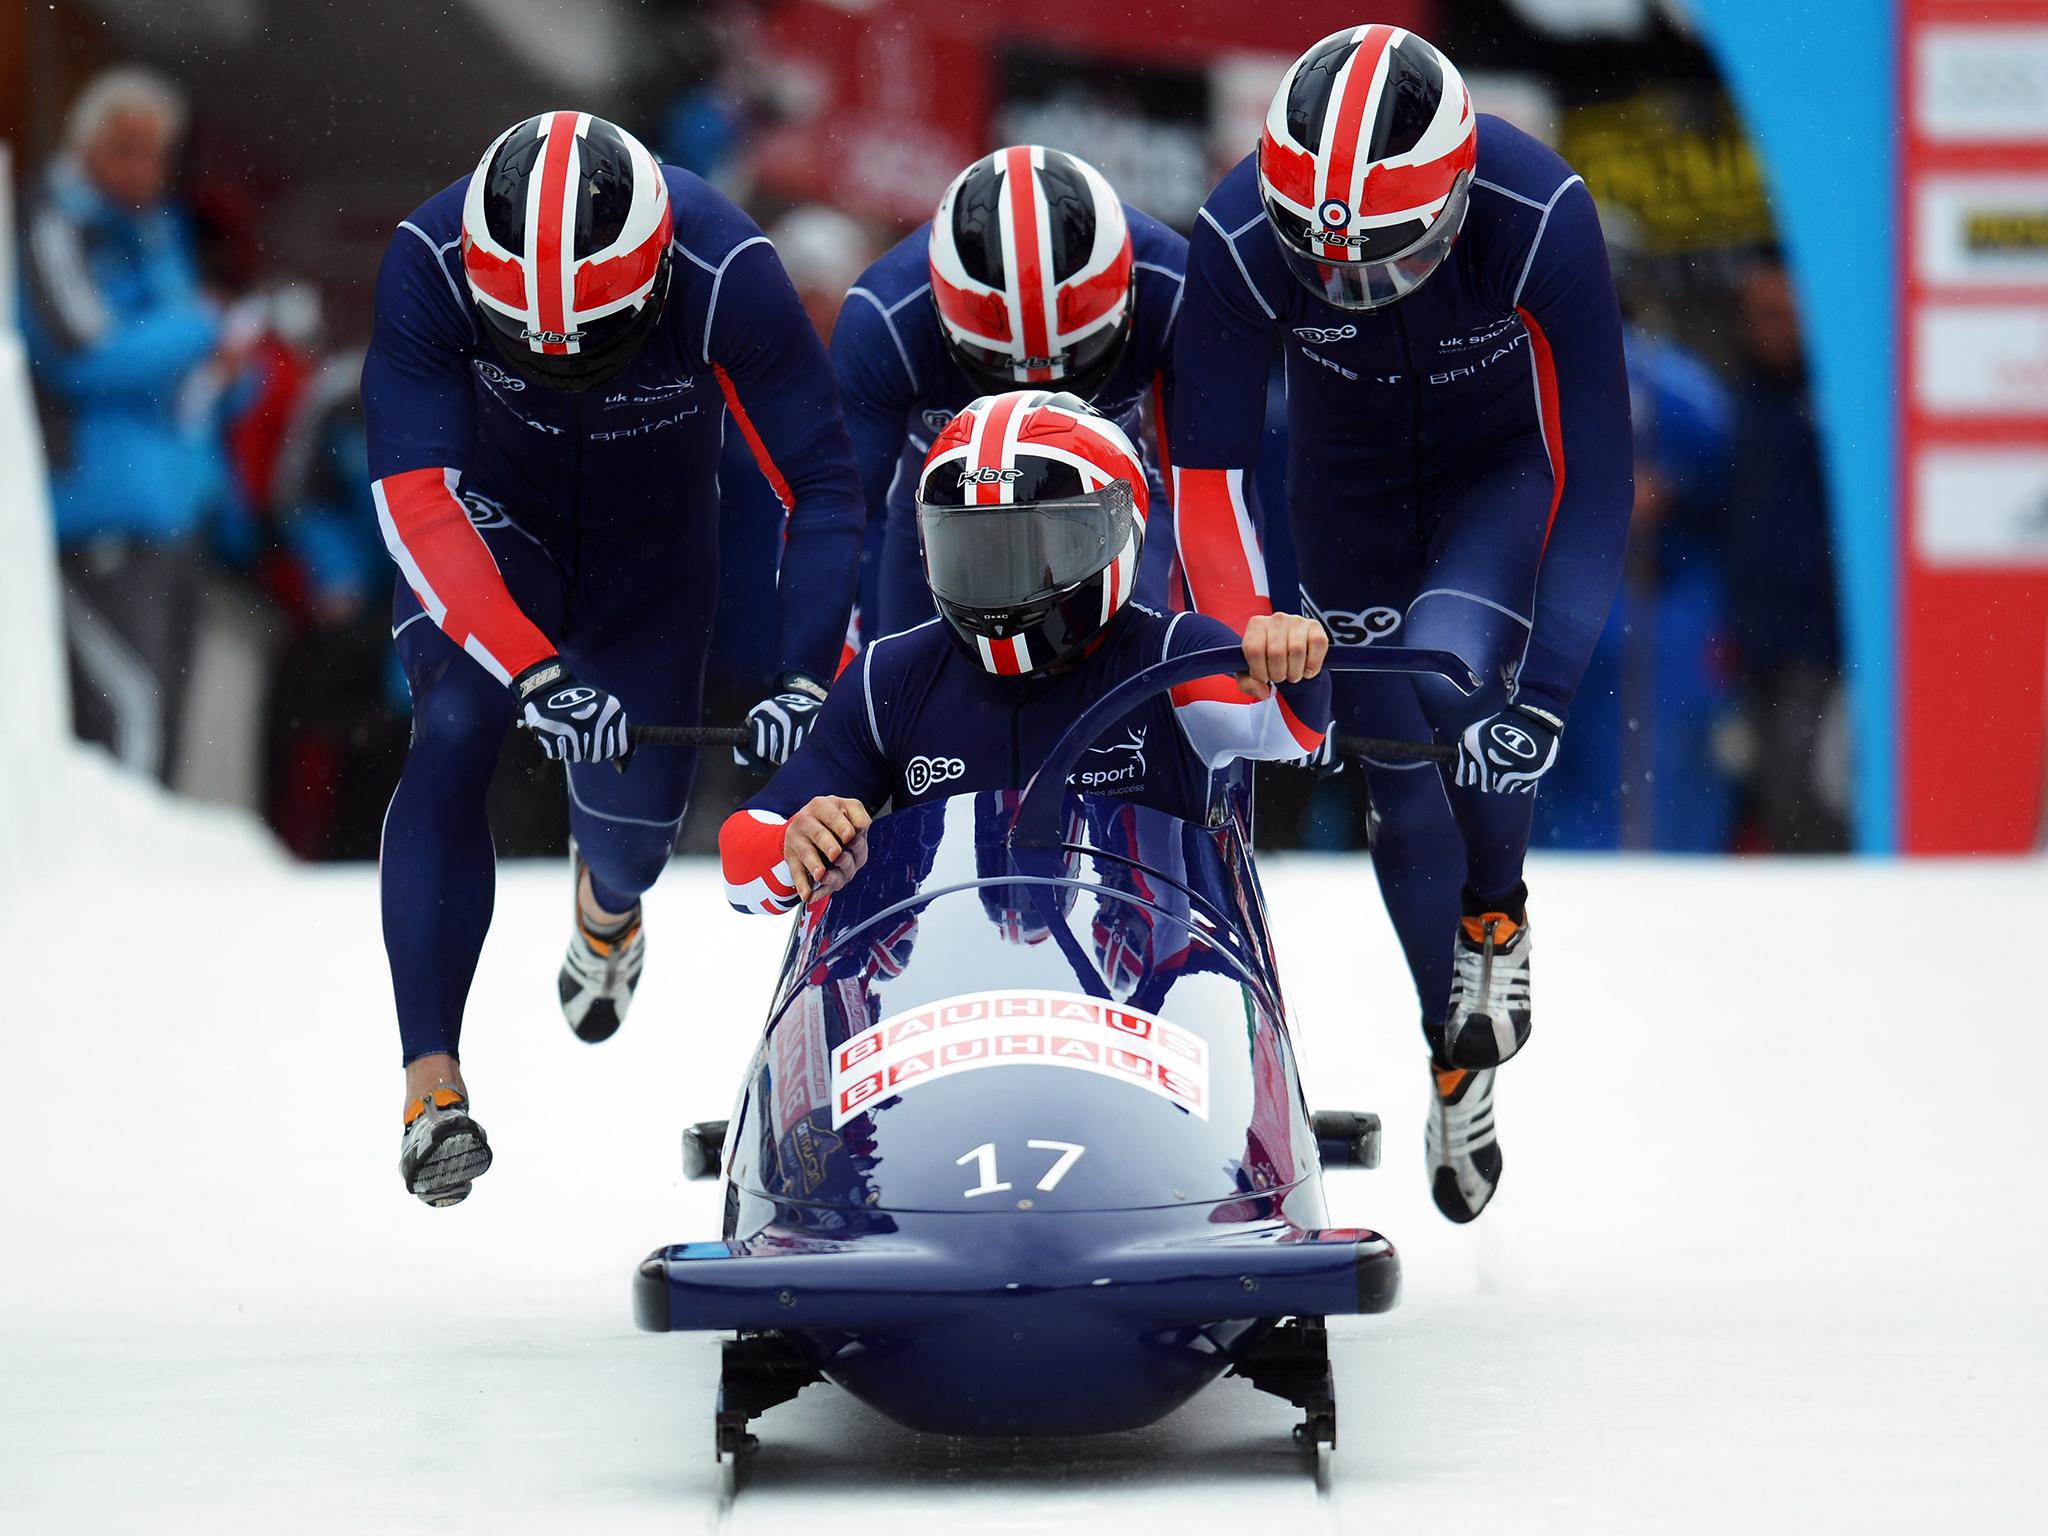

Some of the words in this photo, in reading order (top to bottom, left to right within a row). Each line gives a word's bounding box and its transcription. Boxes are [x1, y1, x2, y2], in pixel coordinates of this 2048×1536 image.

[590, 404, 698, 441] BRITAIN
[1080, 763, 1136, 788] sport
[840, 997, 1203, 1074] BAUHAUS
[840, 1033, 1203, 1115] BAUHAUS
[955, 1138, 1087, 1199] 17
